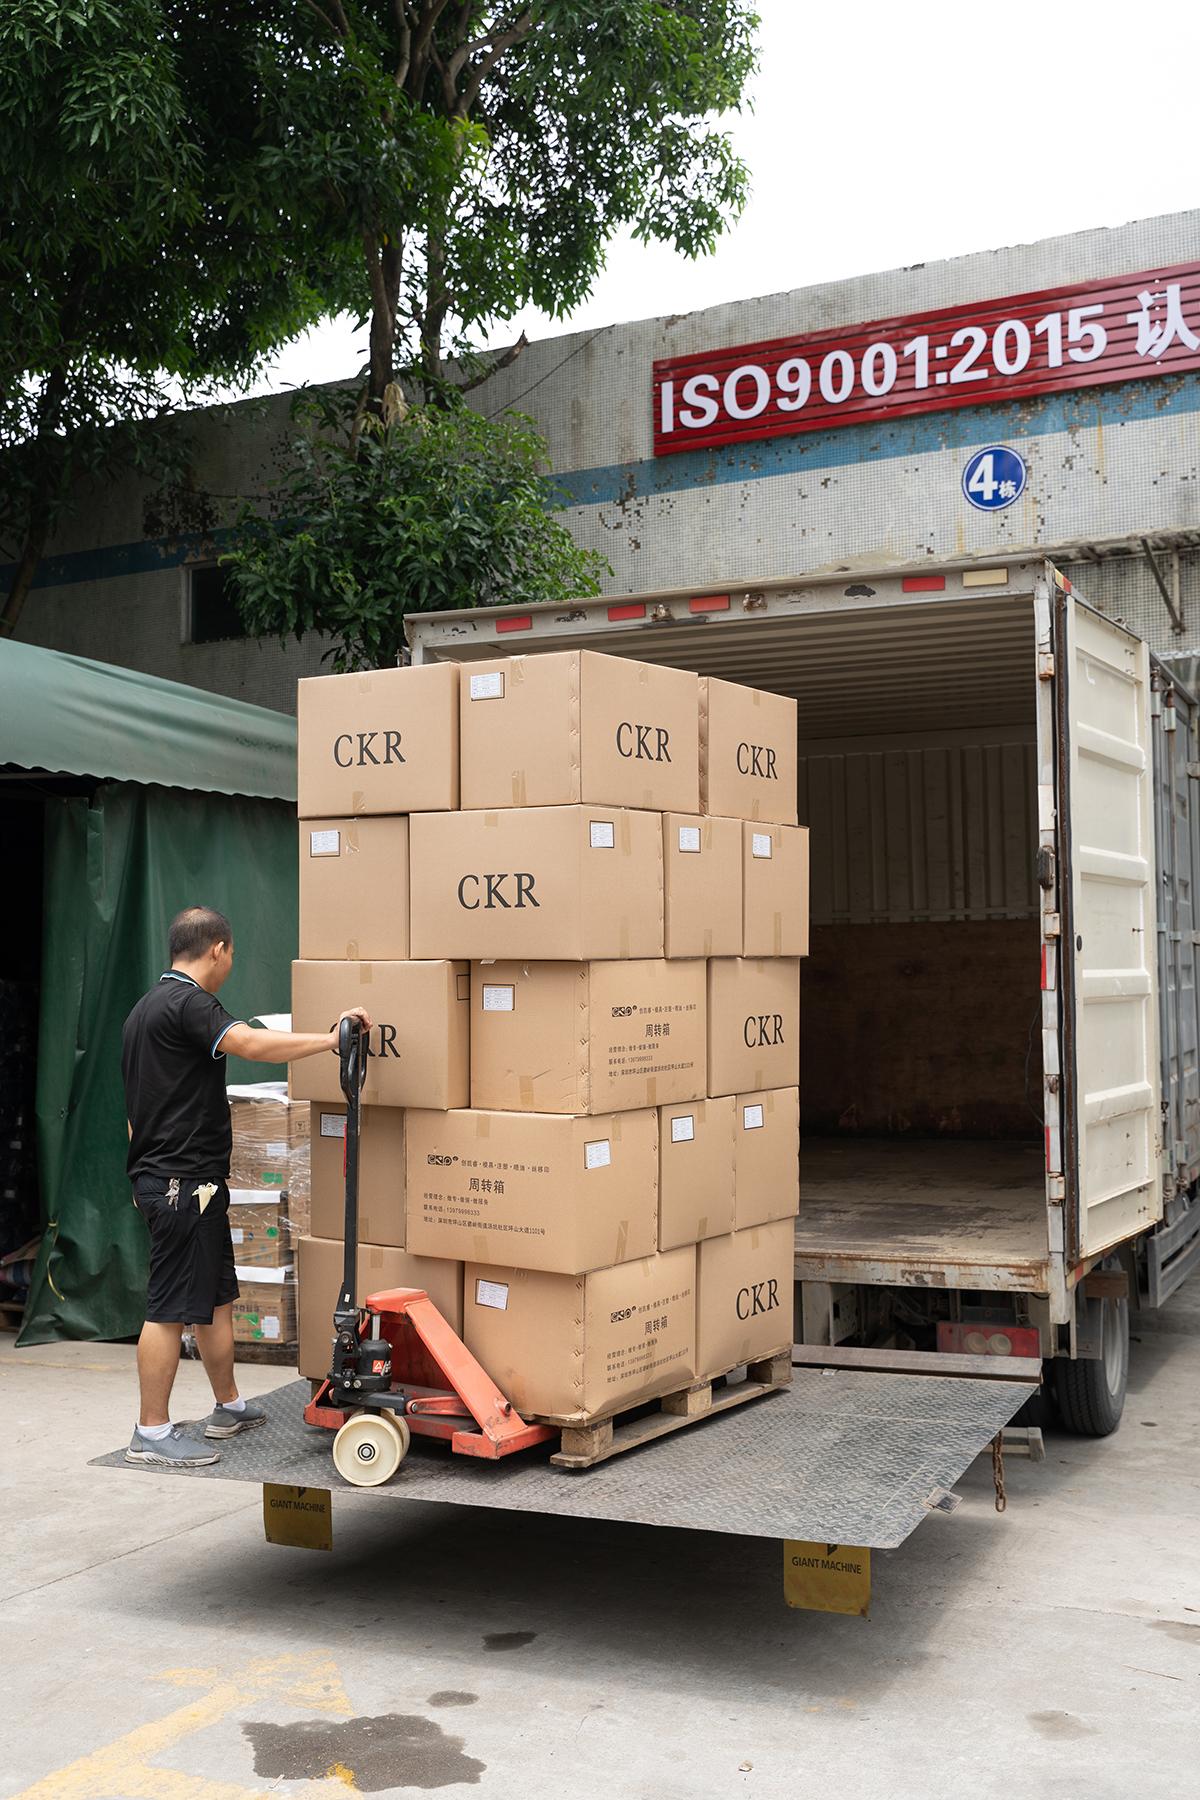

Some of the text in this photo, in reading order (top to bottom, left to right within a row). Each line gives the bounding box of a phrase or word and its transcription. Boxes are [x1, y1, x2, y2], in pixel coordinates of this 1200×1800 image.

[661, 284, 1200, 434] ISO9001:2015 认
[333, 730, 406, 768] CKR
[616, 721, 672, 762] CKR
[736, 742, 778, 780] CKR
[457, 872, 541, 910] CKR
[645, 1023, 670, 1038] 周转箱
[743, 1013, 785, 1049] CKR
[469, 1178, 505, 1195] 周转箱
[736, 1279, 780, 1322] CKR
[270, 1499, 326, 1513] GIANT MACHINE
[792, 1556, 862, 1575] GIANT MACHINE
